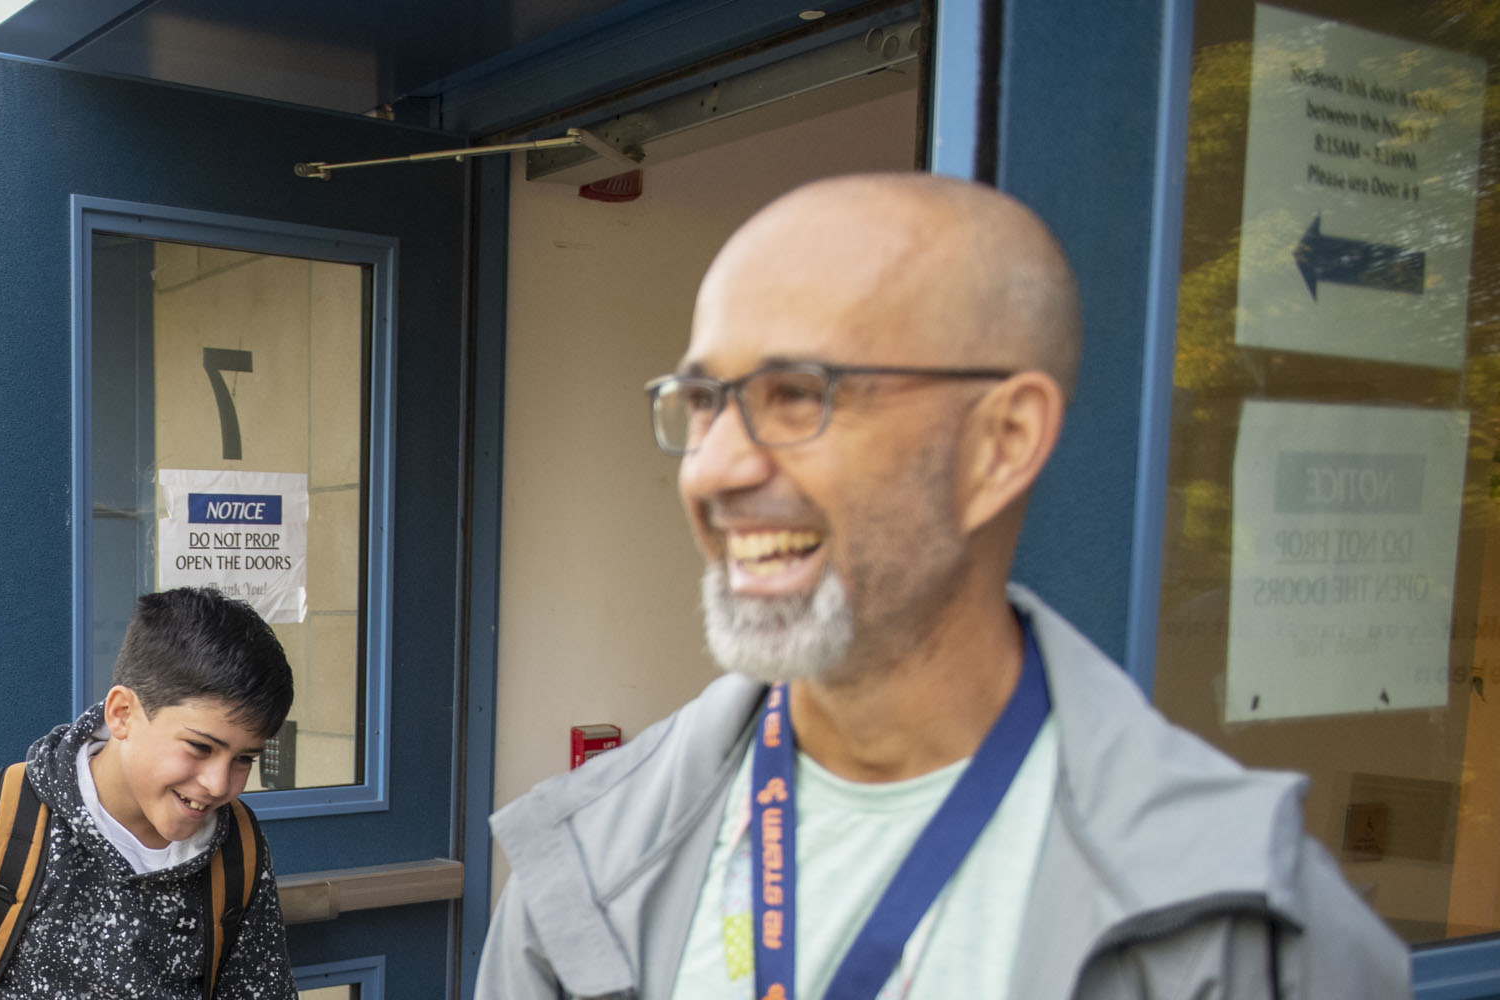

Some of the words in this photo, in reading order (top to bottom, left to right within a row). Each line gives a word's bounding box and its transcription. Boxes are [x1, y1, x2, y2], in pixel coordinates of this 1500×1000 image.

[1306, 98, 1358, 126] between
[1361, 111, 1381, 132] the
[1307, 164, 1345, 189] Please
[203, 347, 253, 460] 7
[206, 501, 266, 520] NOTICE
[189, 532, 210, 548] DO
[214, 533, 242, 548] NOT
[245, 533, 280, 548] PROP
[175, 555, 212, 570] OPEN
[216, 555, 241, 570] THE
[245, 555, 292, 570] DOORS
[243, 582, 267, 595] You!
